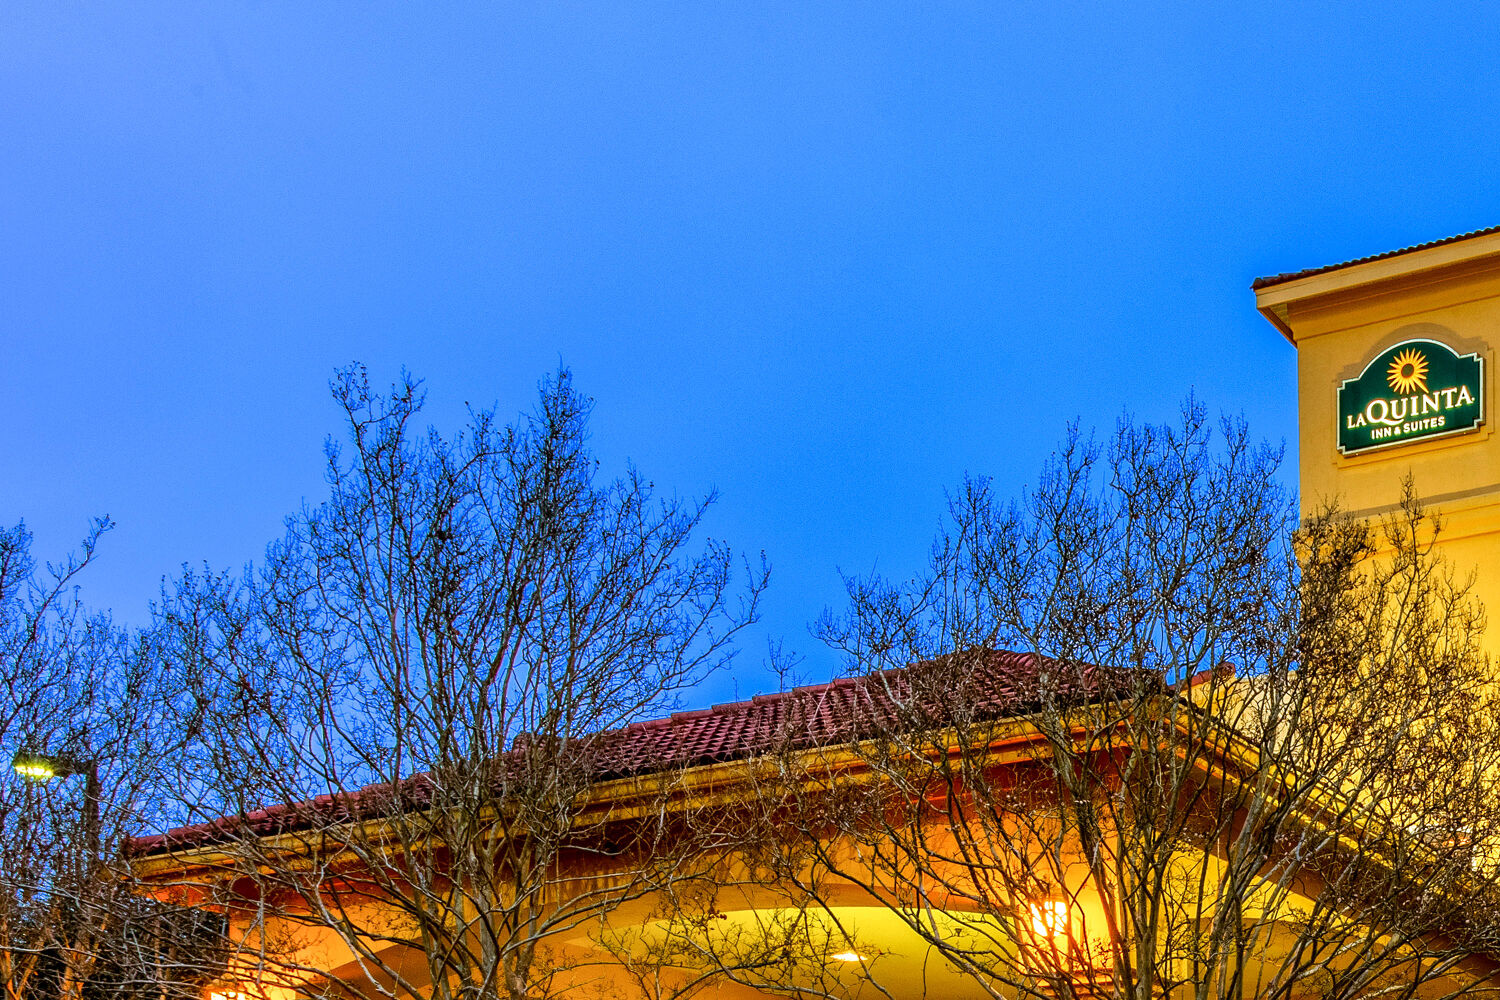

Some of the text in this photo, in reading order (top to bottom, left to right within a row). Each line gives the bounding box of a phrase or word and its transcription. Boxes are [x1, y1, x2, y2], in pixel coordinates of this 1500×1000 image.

[1347, 385, 1471, 429] LA QUINTA
[1371, 416, 1445, 440] INN & SUITES
